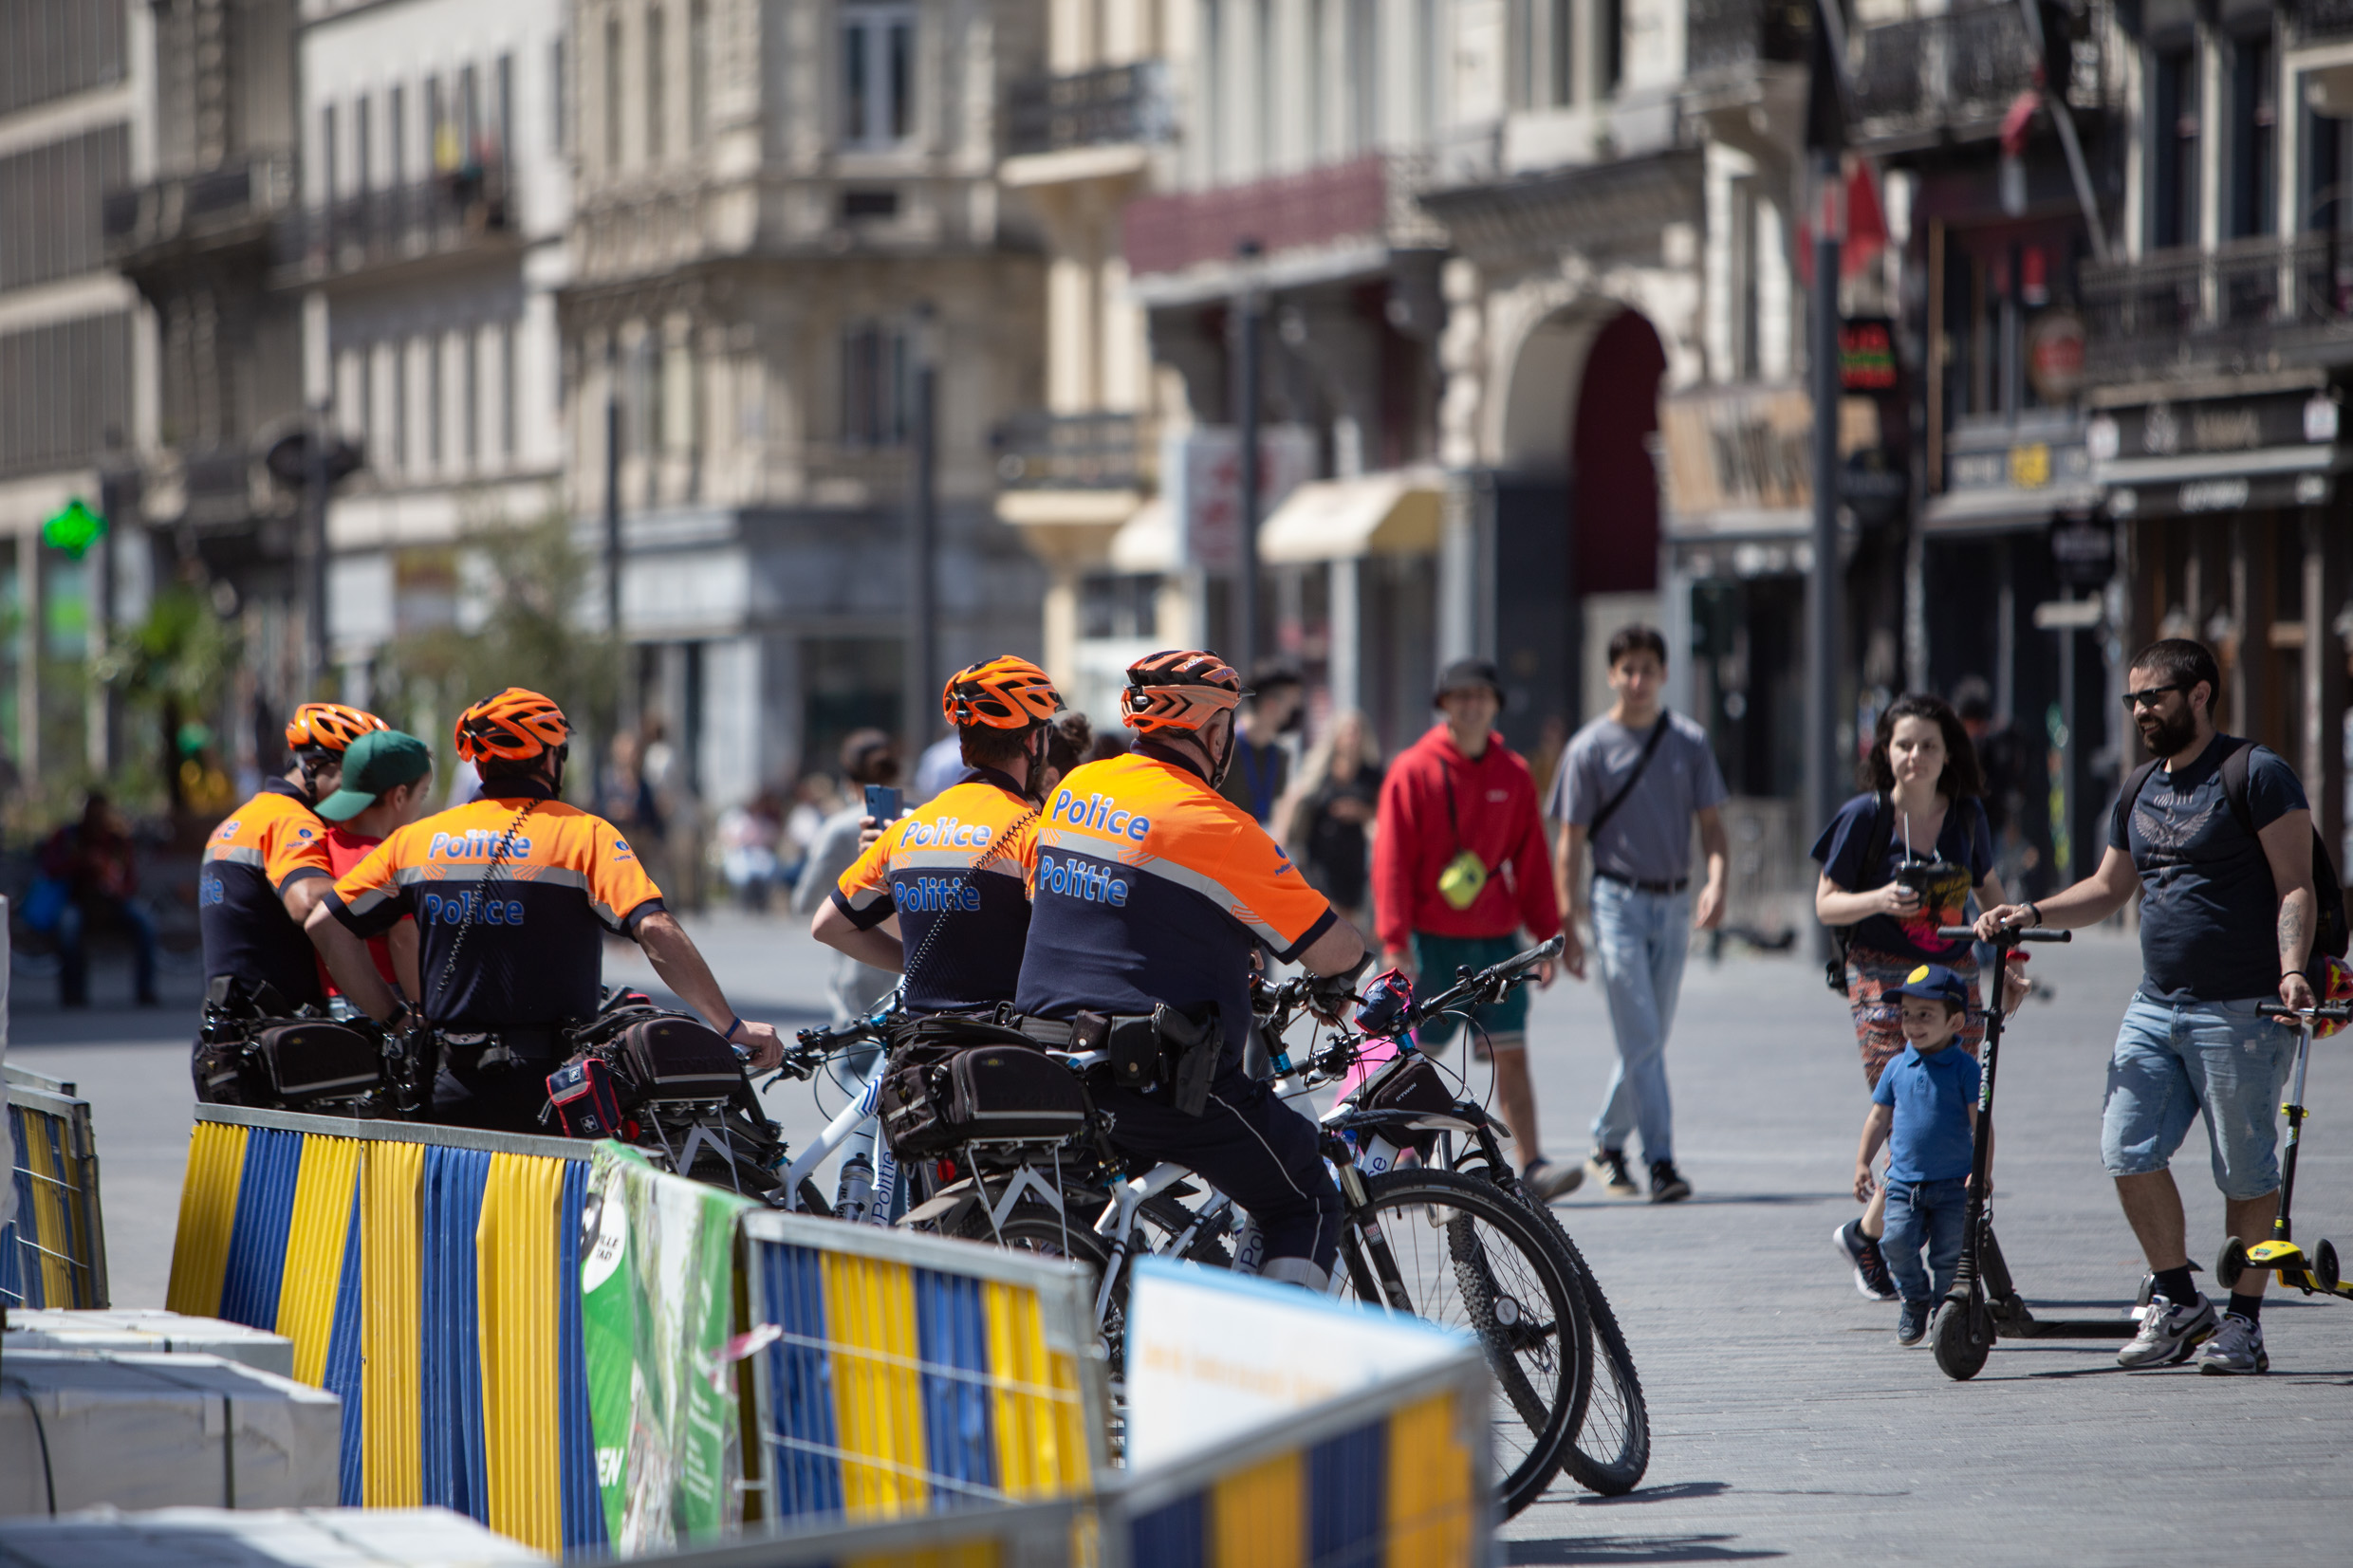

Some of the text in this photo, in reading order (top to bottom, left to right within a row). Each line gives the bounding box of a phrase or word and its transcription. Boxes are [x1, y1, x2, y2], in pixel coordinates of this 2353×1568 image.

[899, 817, 992, 848] Police
[1051, 788, 1151, 841] Police
[428, 828, 531, 859] Politie
[894, 876, 981, 913] Politie
[1039, 855, 1129, 908] Politie
[424, 890, 524, 925] Police
[872, 1151, 896, 1222] Politie
[595, 1447, 624, 1487] EN
